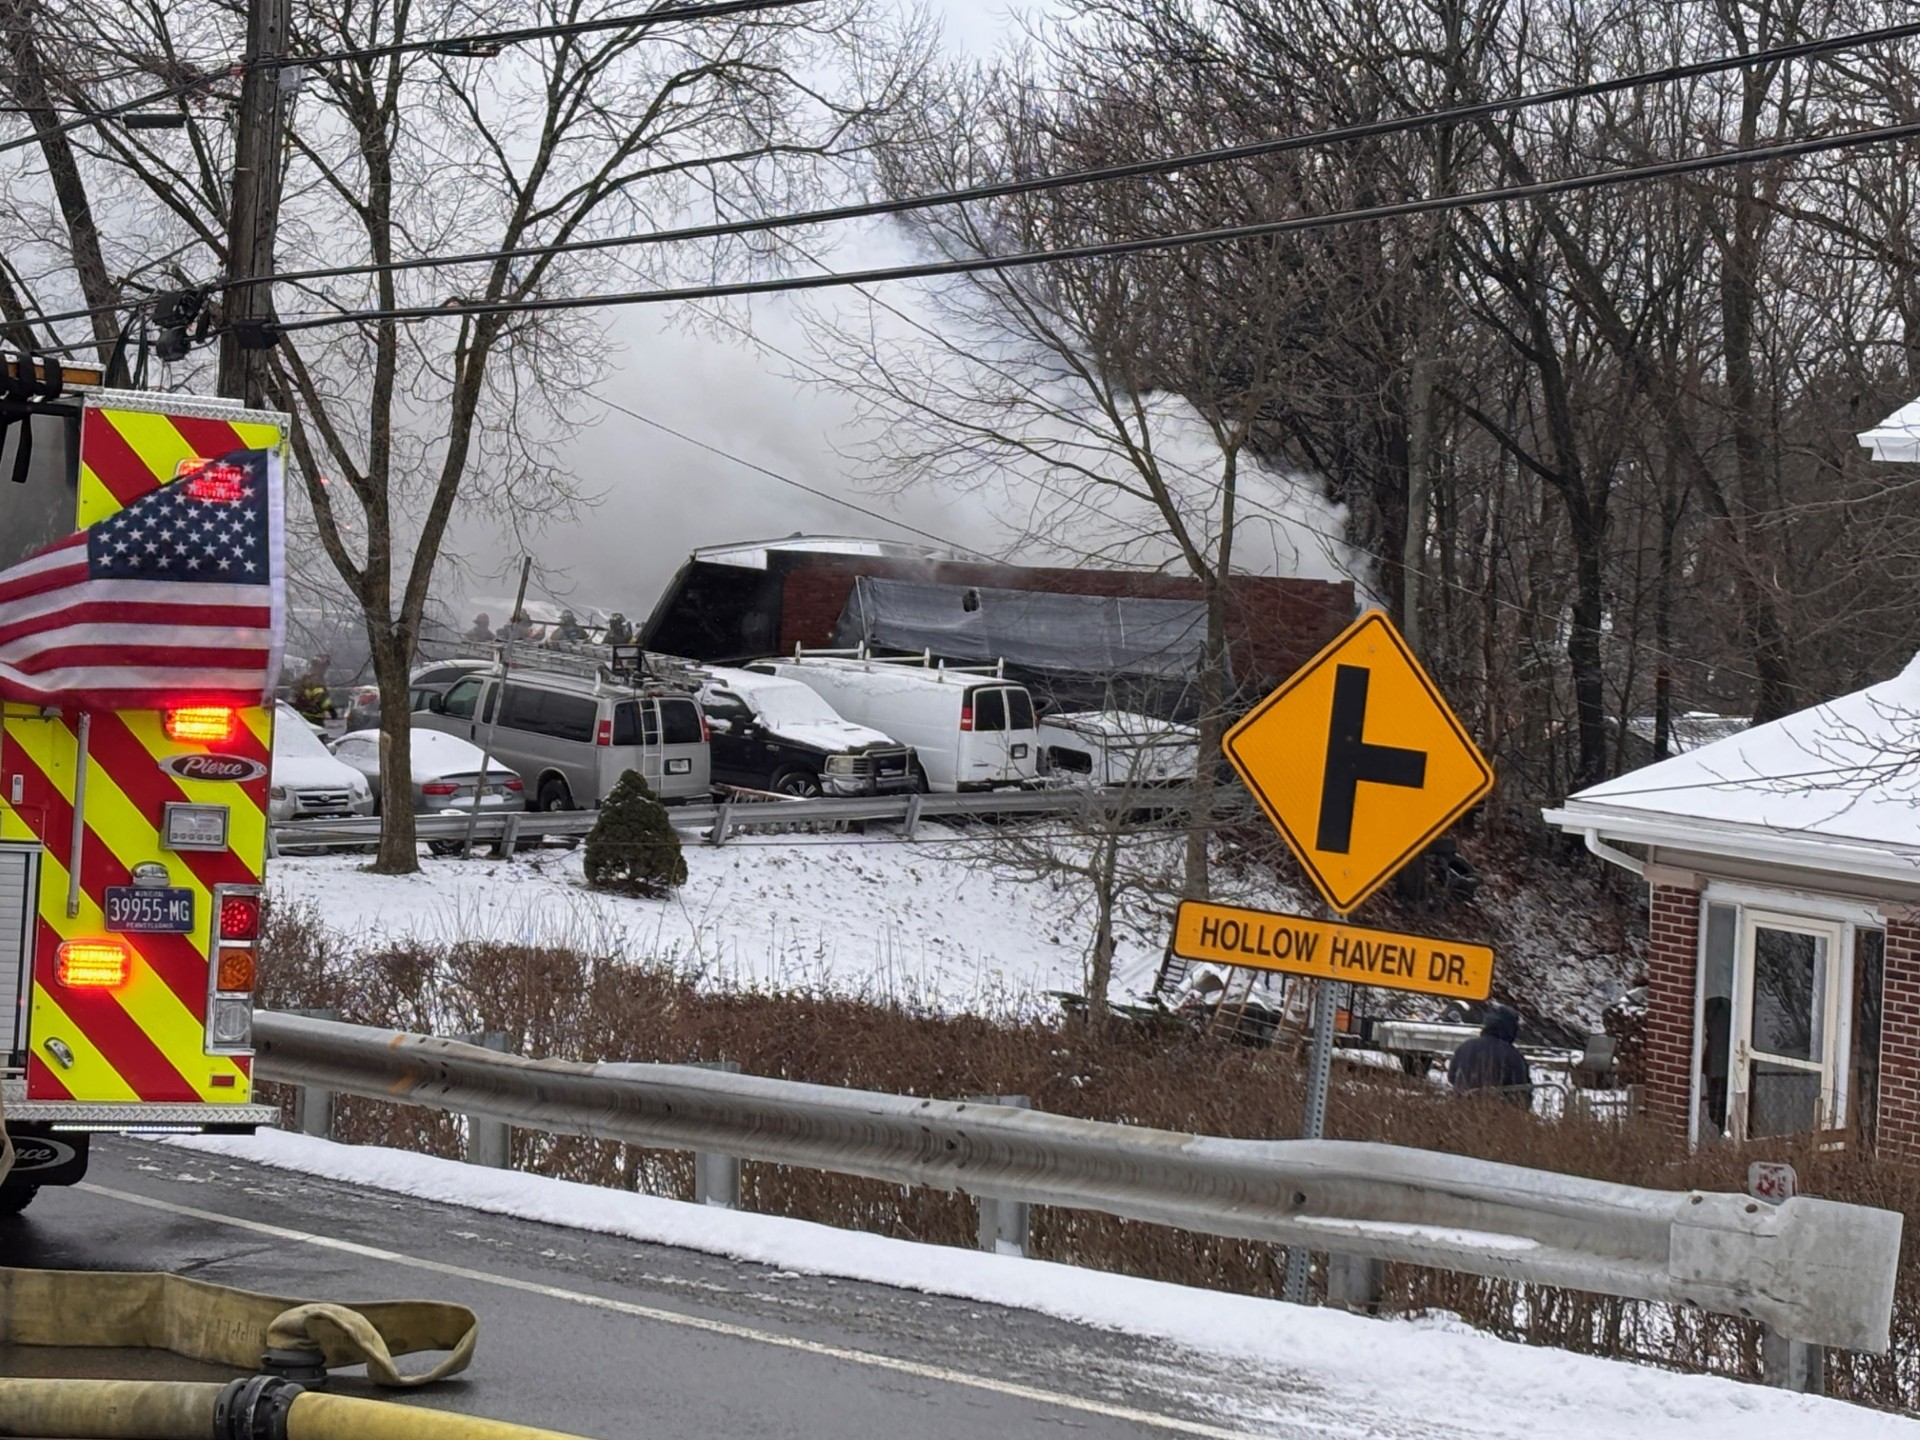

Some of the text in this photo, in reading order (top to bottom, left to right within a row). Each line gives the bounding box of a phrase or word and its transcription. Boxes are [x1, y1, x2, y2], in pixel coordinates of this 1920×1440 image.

[182, 756, 243, 776] Pierce
[109, 897, 190, 921] 39955-MG
[126, 921, 174, 929] PENNSYLVANIA
[1200, 916, 1470, 987] HOLLOW HAVEN DR.
